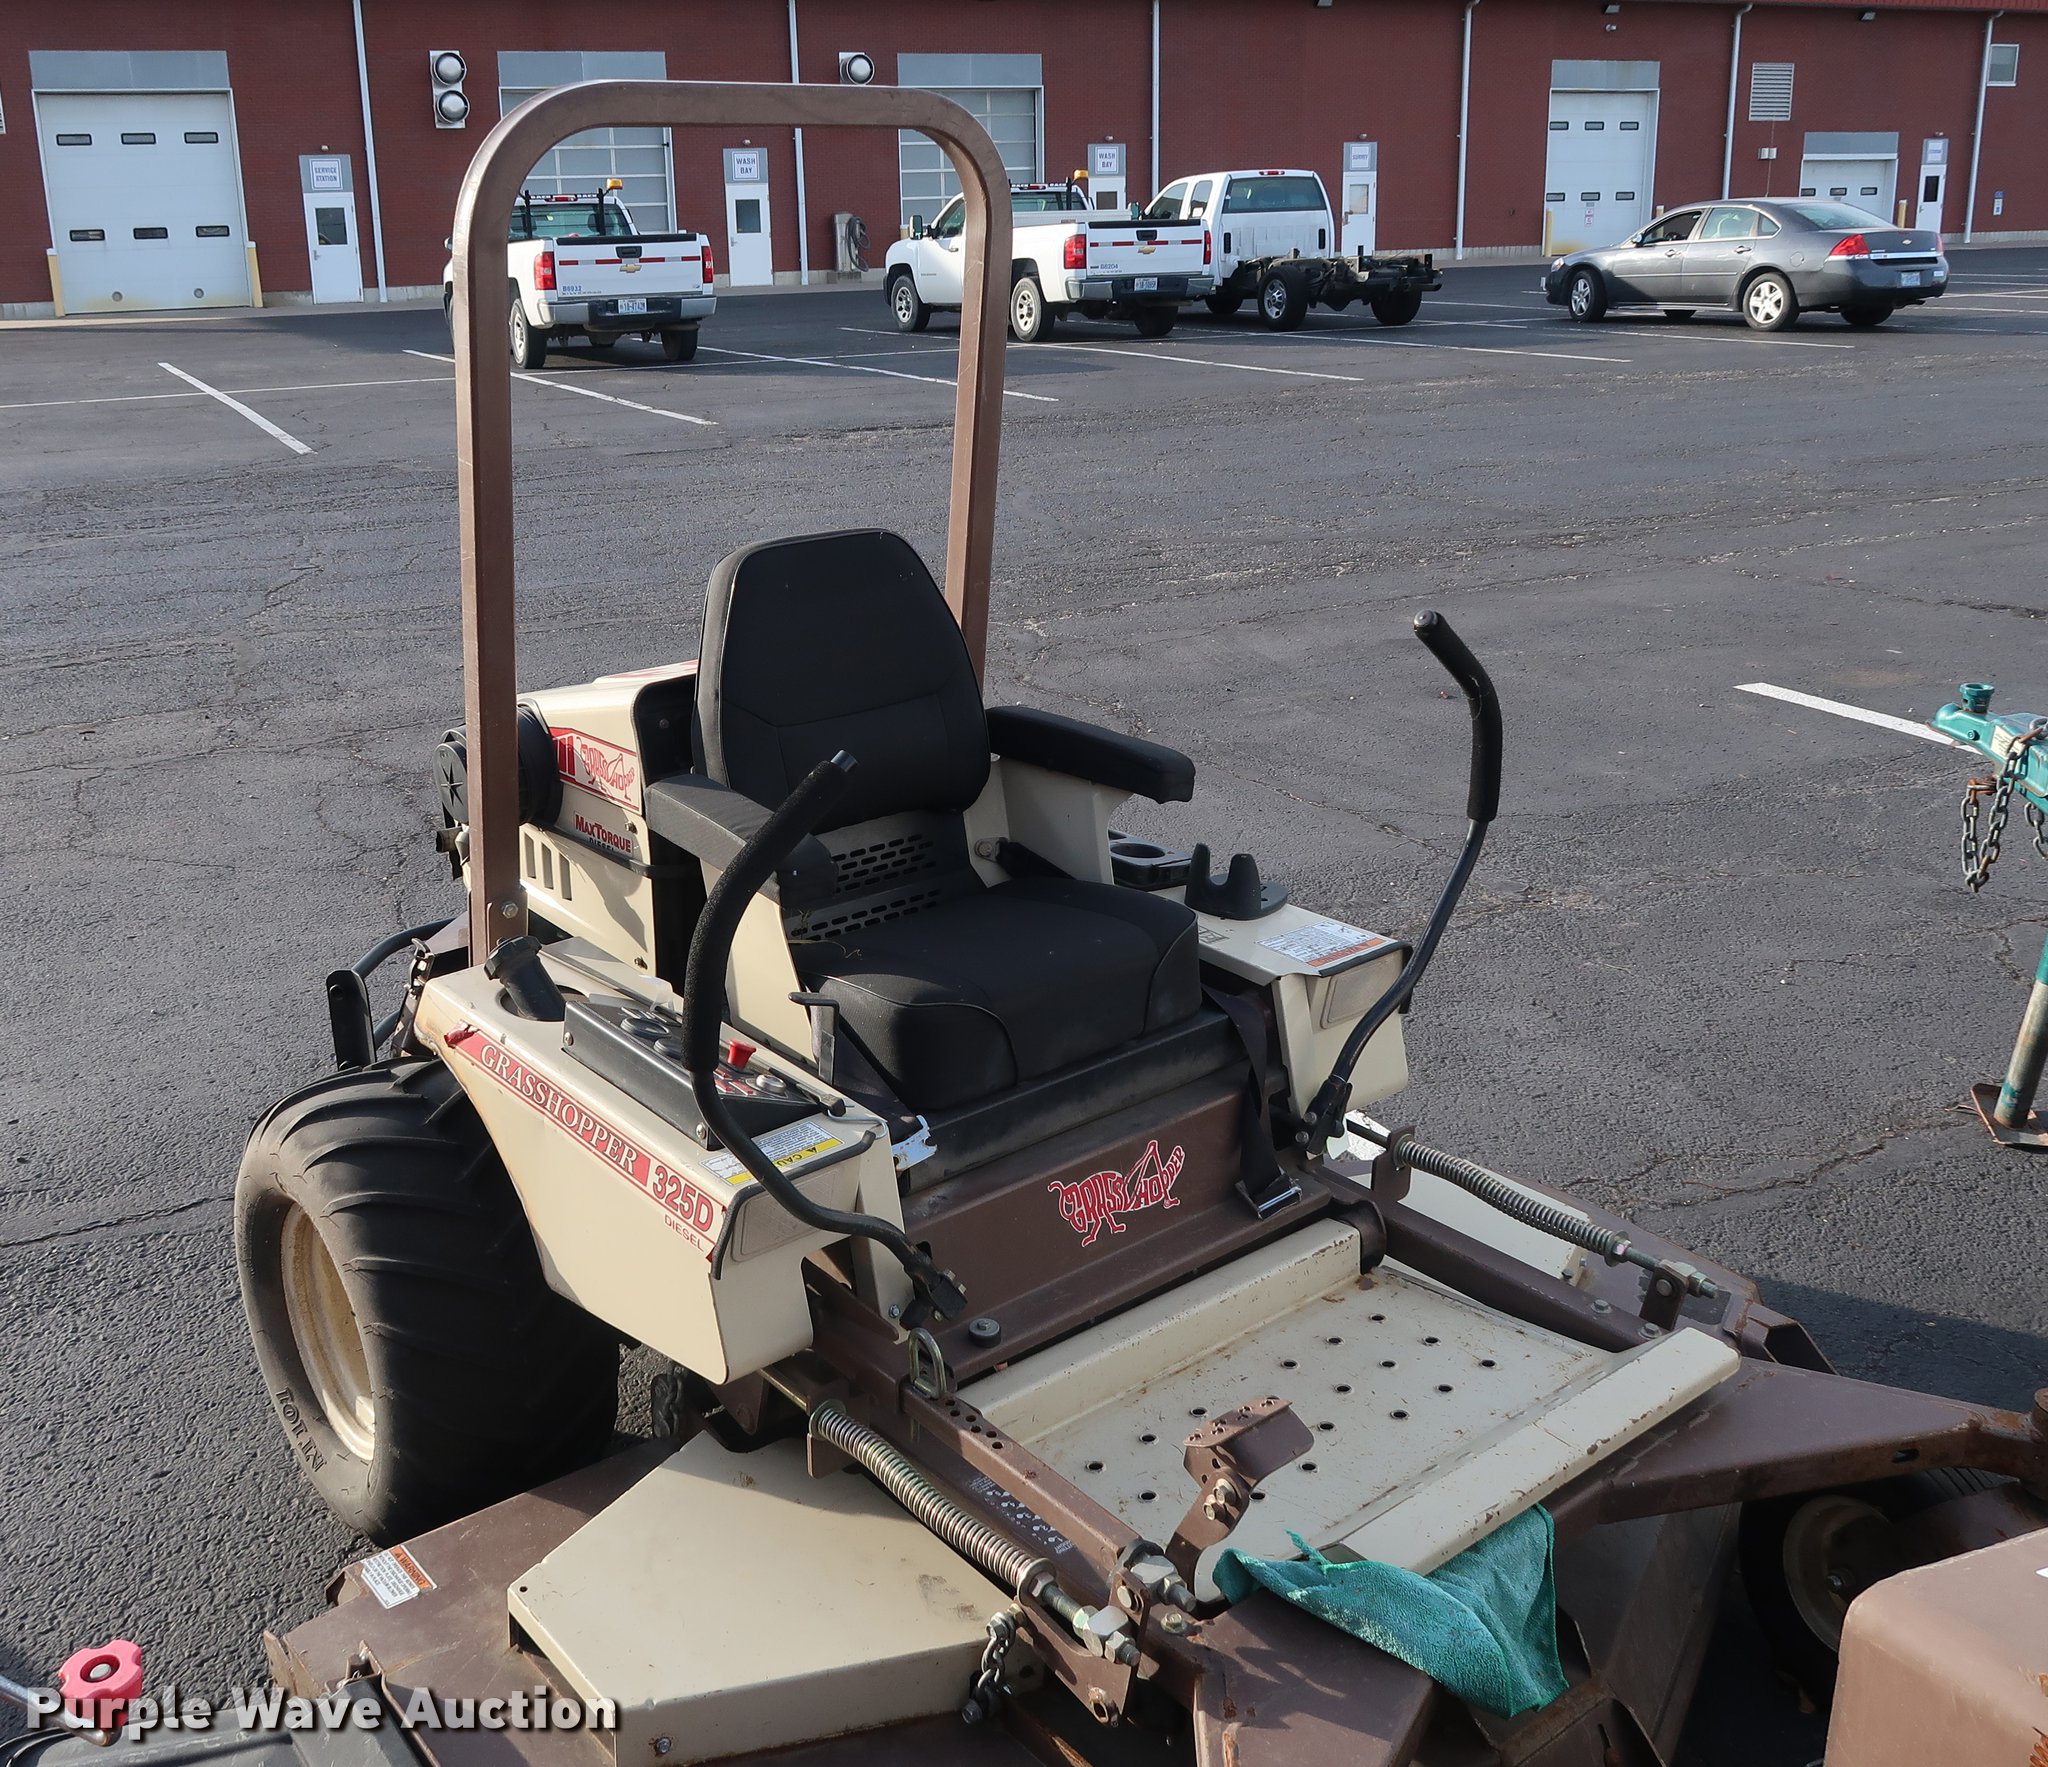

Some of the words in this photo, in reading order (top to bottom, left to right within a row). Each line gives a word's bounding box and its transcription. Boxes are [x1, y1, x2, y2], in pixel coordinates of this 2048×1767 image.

[480, 1044, 638, 1175] GRASSHOPPER
[653, 1165, 714, 1233] 325D
[664, 1213, 704, 1252] DIESEL
